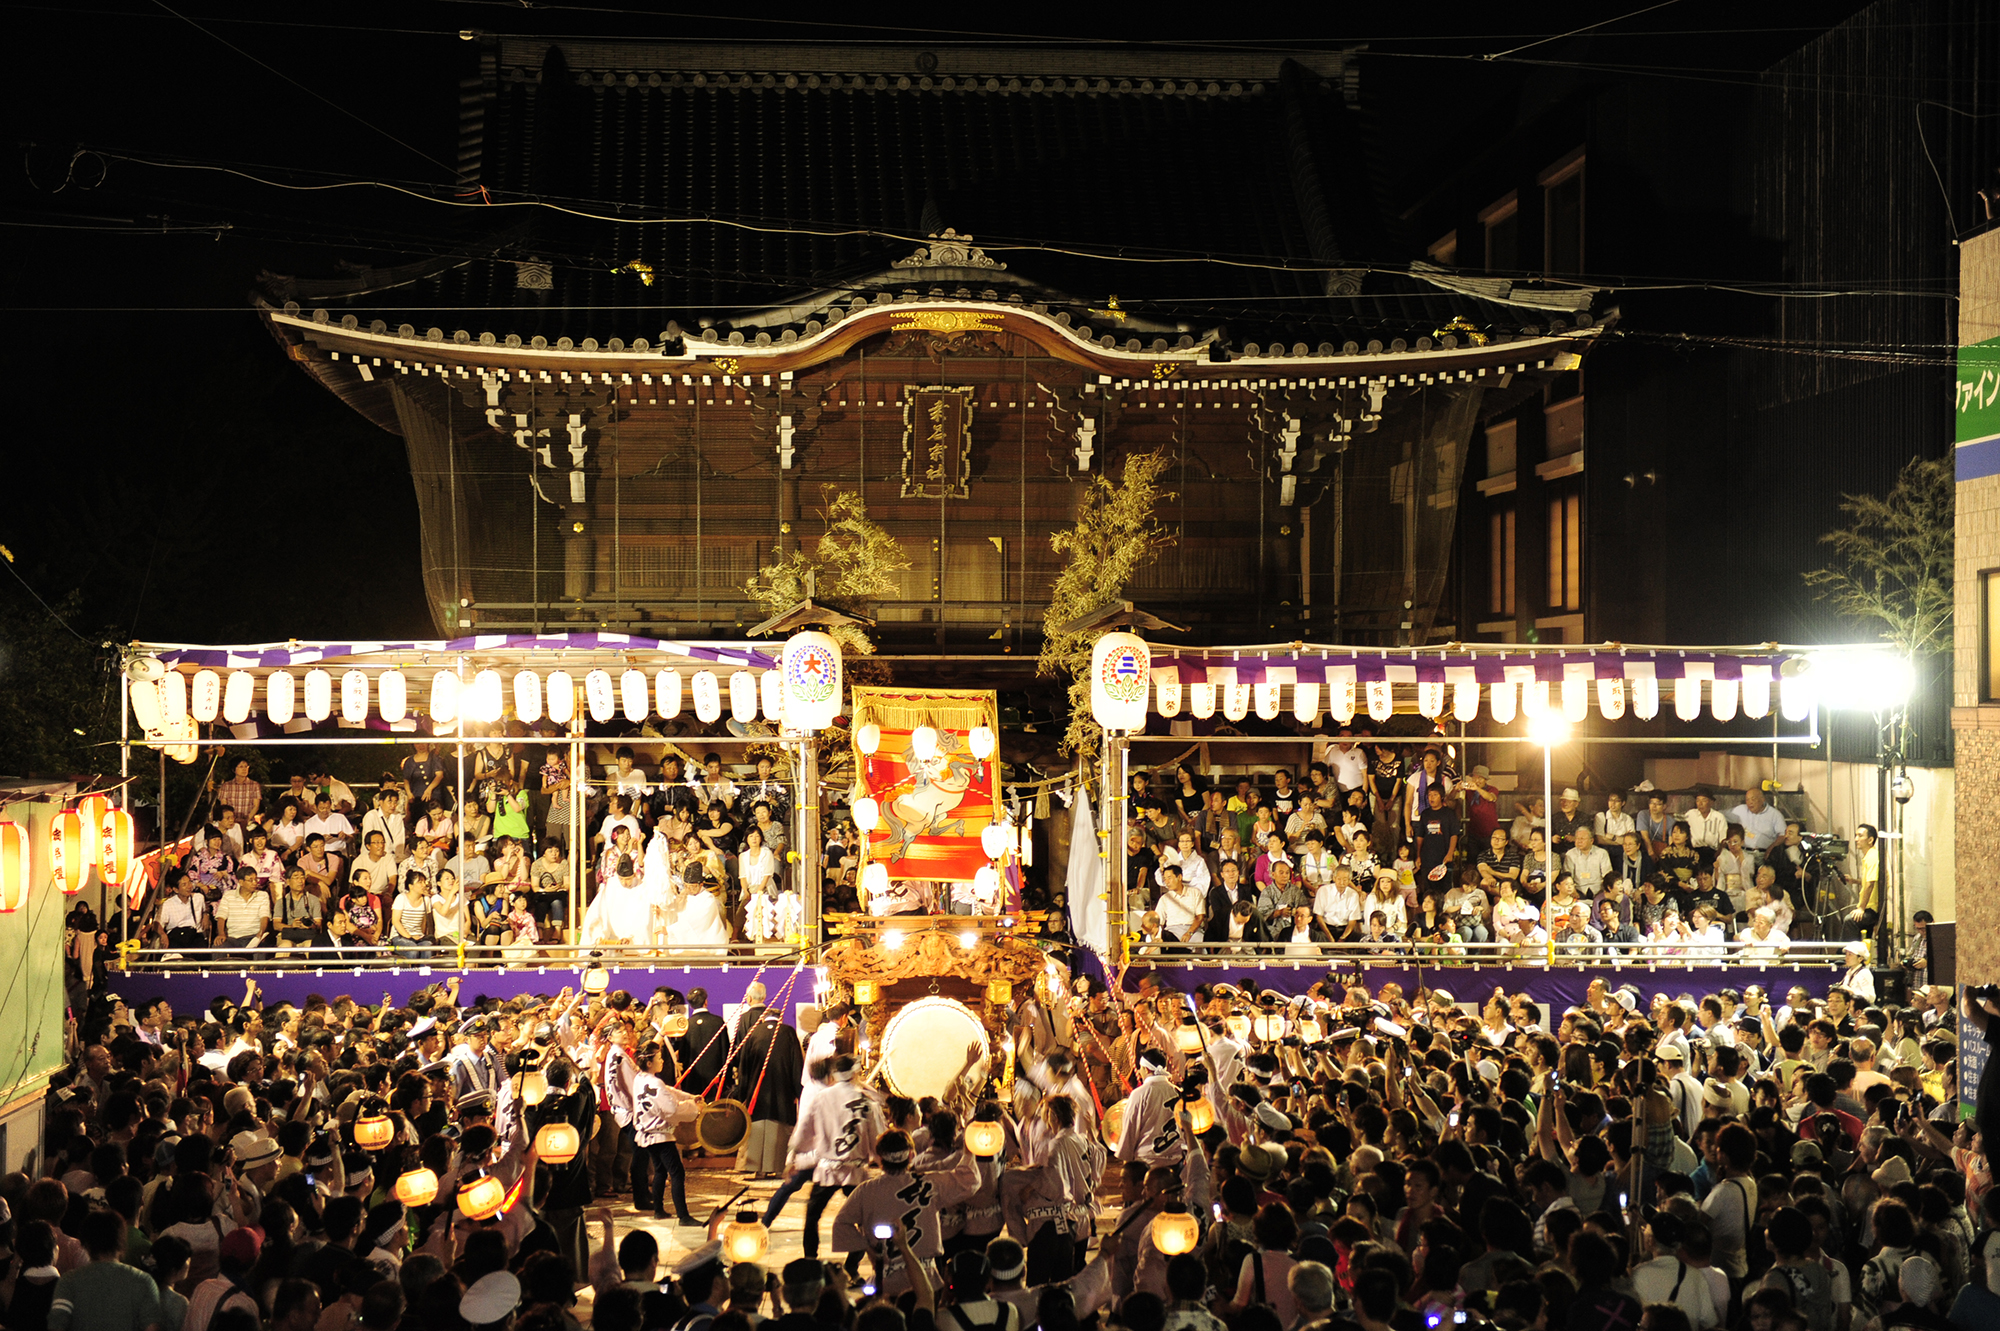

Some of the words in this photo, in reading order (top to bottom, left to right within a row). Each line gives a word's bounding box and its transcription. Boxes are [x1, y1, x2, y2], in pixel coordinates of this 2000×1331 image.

[803, 653, 822, 674] 大
[1117, 656, 1138, 675] 三
[1165, 675, 1176, 711] 石取祭
[1373, 675, 1384, 711] 石取祭
[1610, 675, 1623, 711] 石取祭
